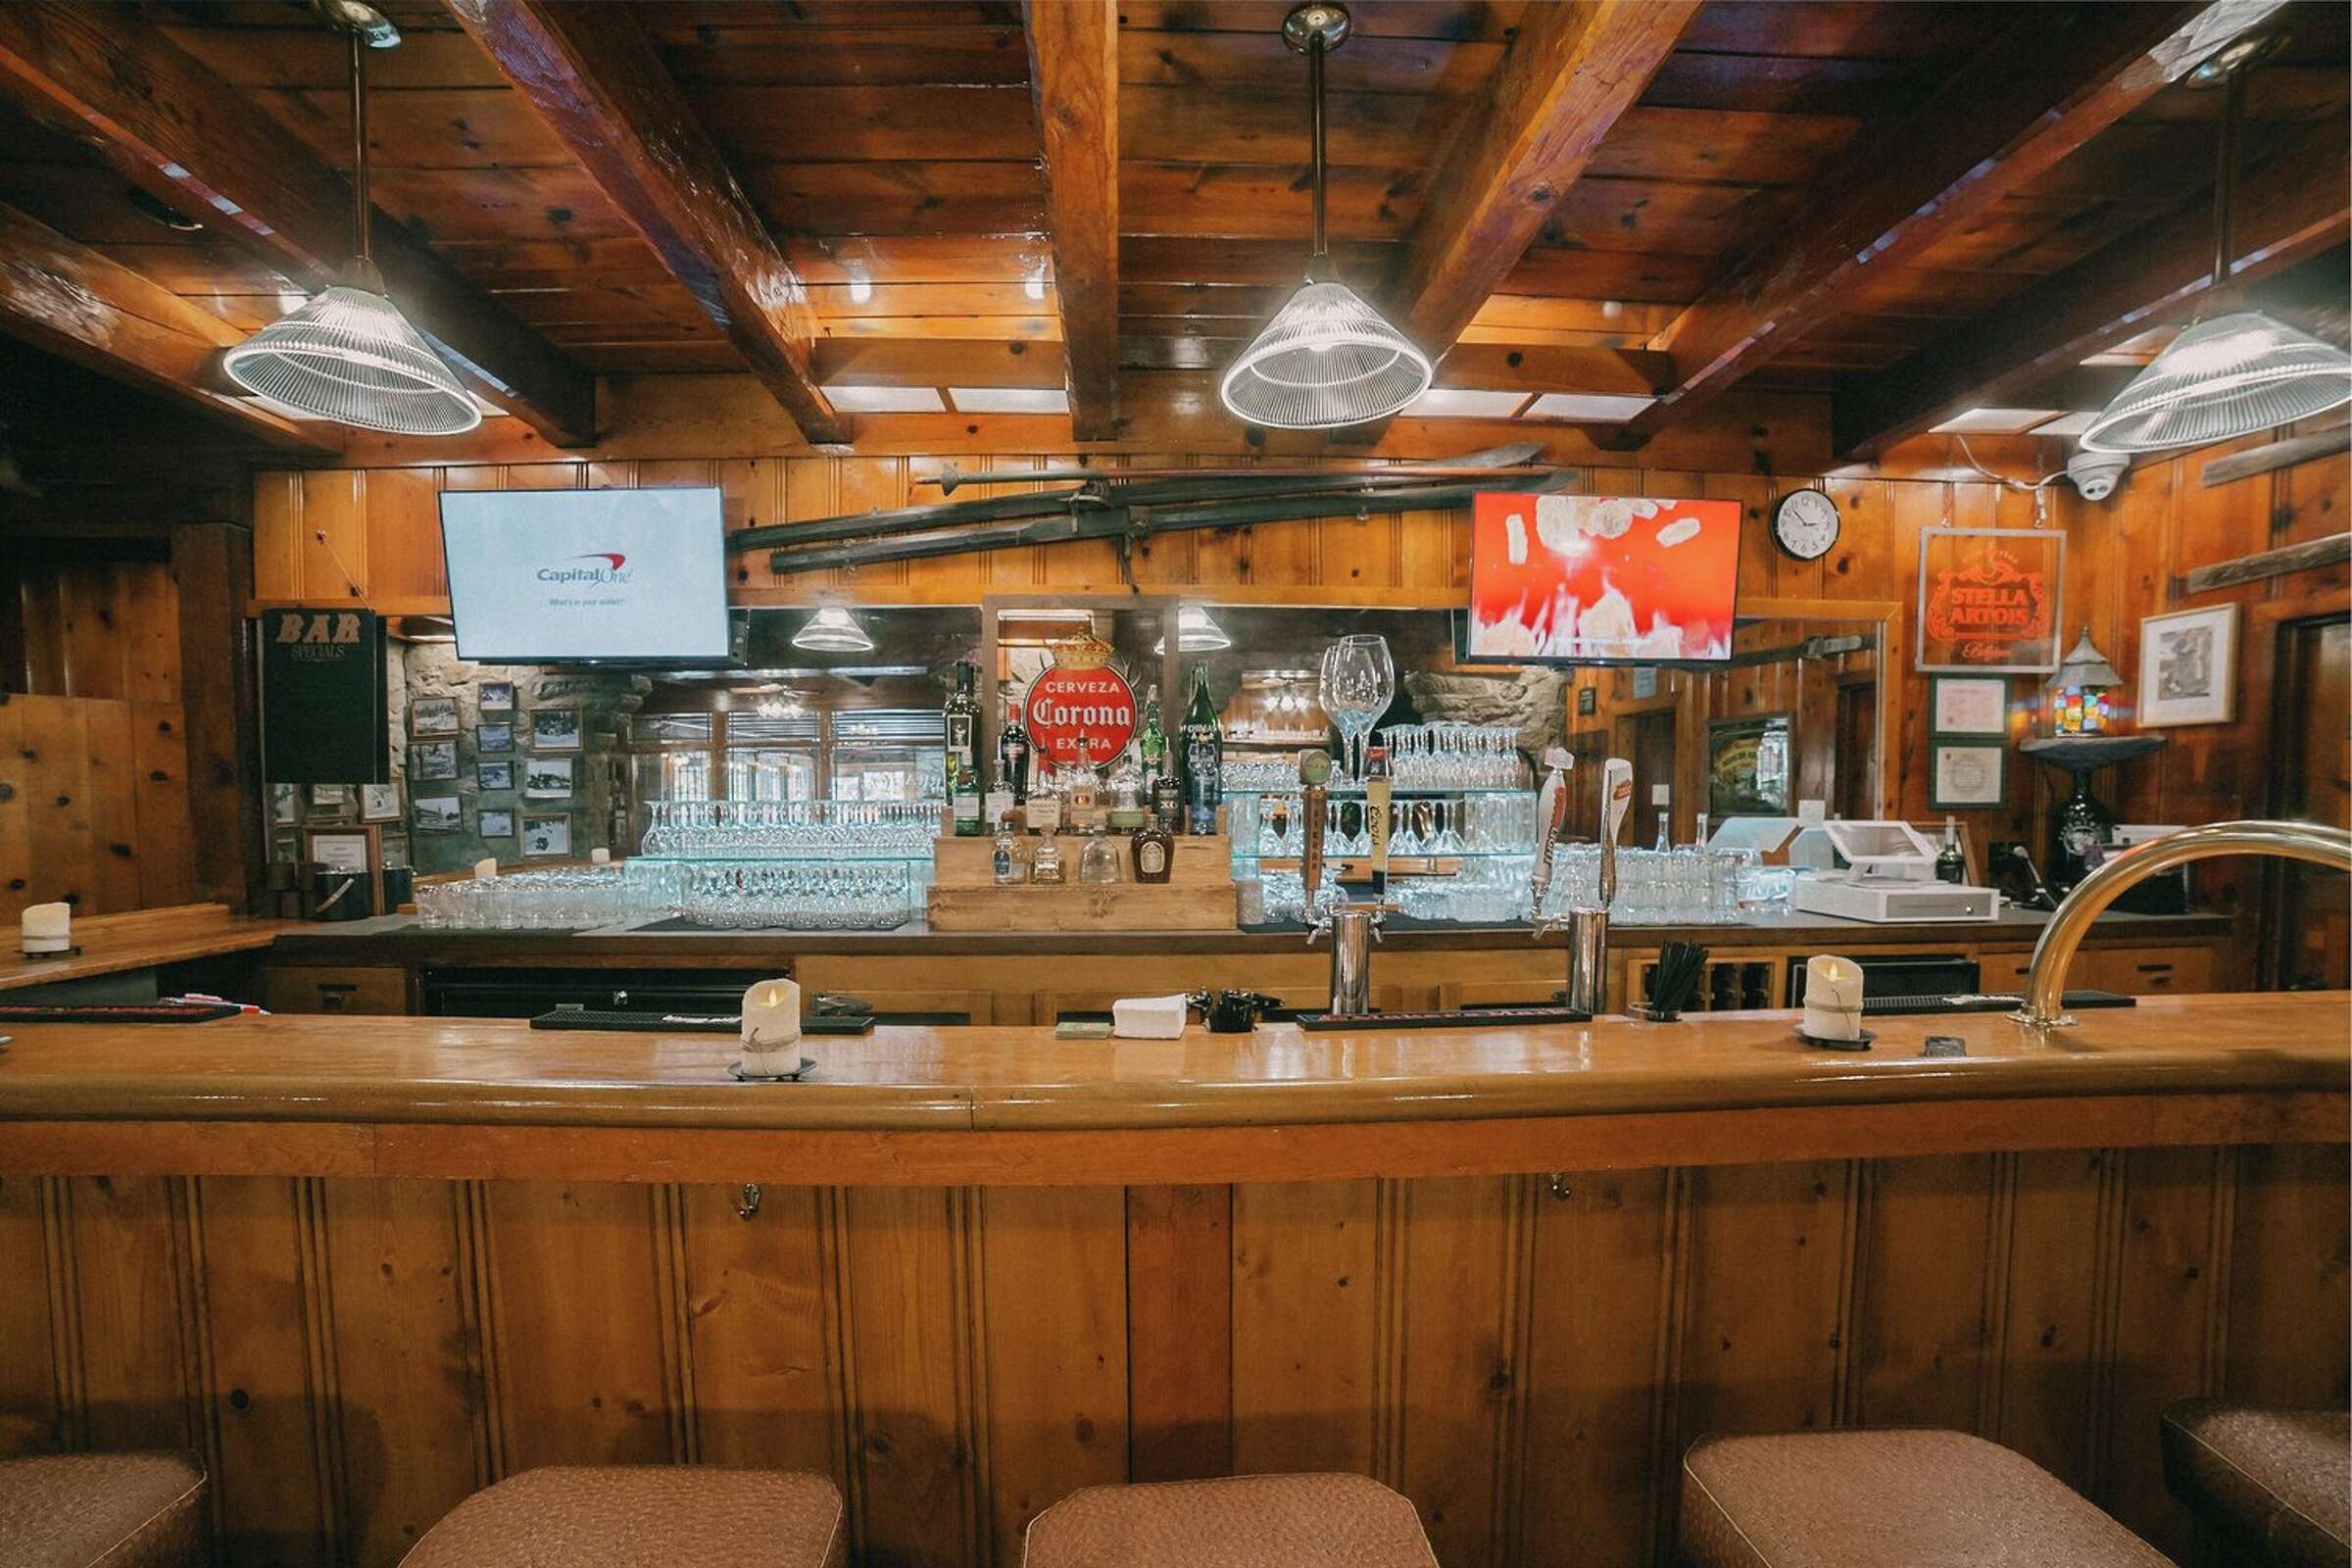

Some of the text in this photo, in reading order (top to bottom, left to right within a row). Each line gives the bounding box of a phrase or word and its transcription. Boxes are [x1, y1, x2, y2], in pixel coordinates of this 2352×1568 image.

[536, 568, 599, 583] Capital
[1951, 588, 2027, 606] STELLA
[1950, 608, 2029, 624] ARTOIS
[276, 613, 361, 644] BAR
[291, 645, 345, 659] SPECIALS
[1046, 681, 1120, 694] CERVEZA
[1033, 698, 1130, 729] Corona
[1055, 737, 1112, 751] EXRA
